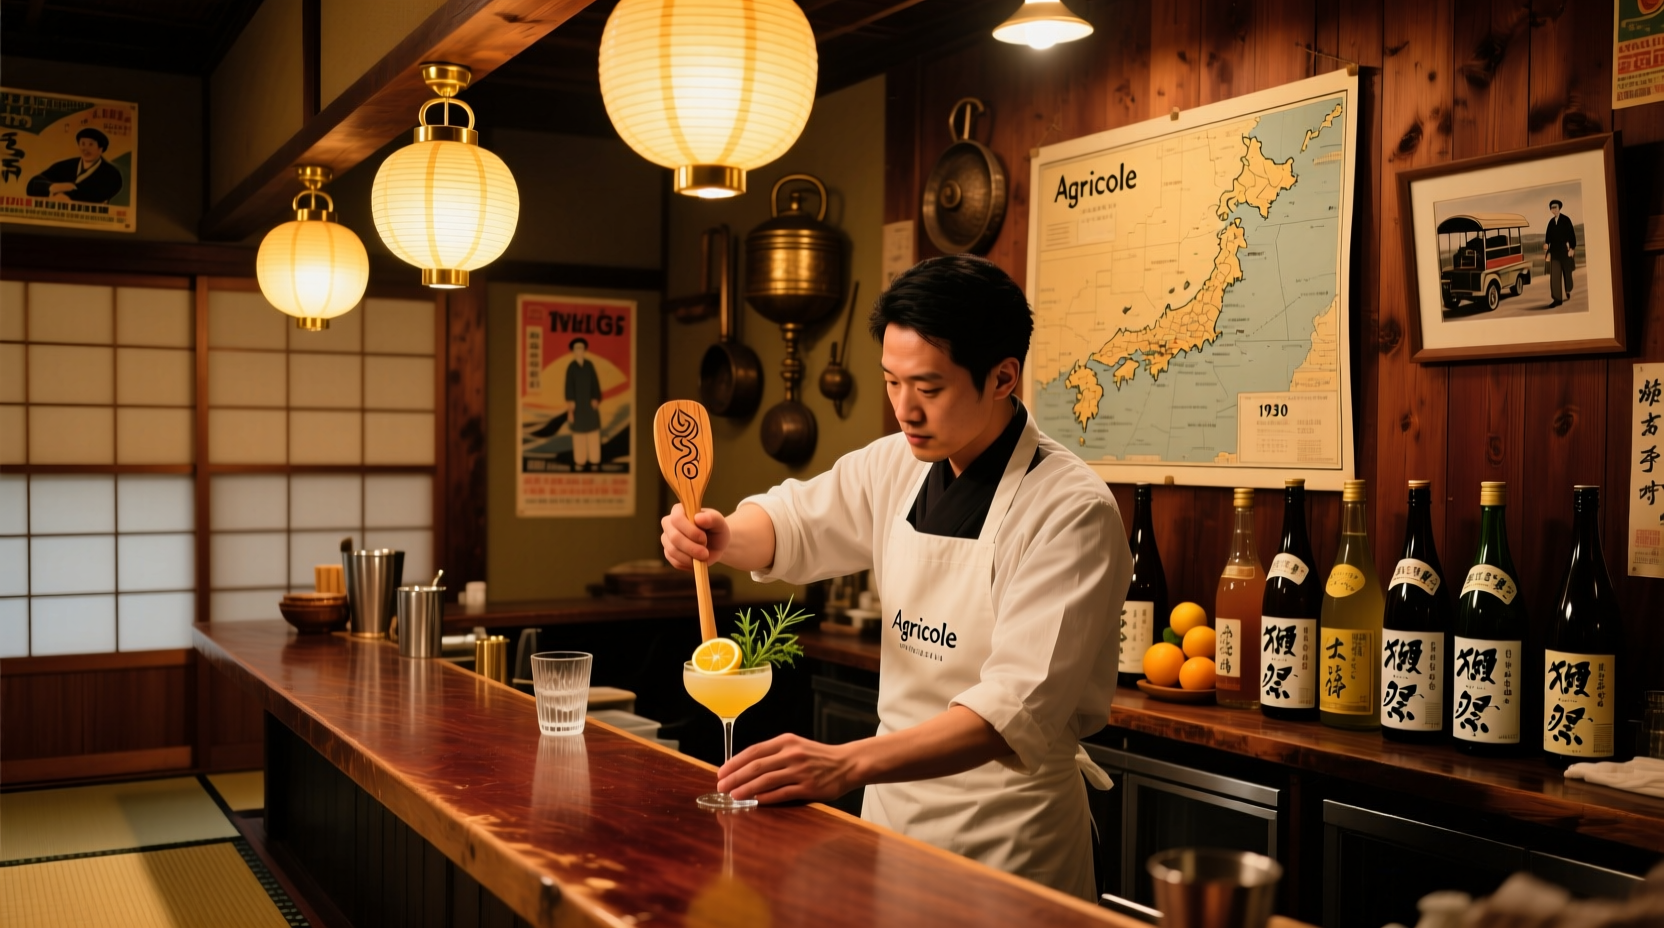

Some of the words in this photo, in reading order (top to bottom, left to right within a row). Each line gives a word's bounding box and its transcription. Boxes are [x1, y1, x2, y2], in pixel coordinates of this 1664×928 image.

[1054, 163, 1137, 208] Agricole
[1259, 403, 1288, 418] 1930
[891, 609, 957, 649] Agricole
